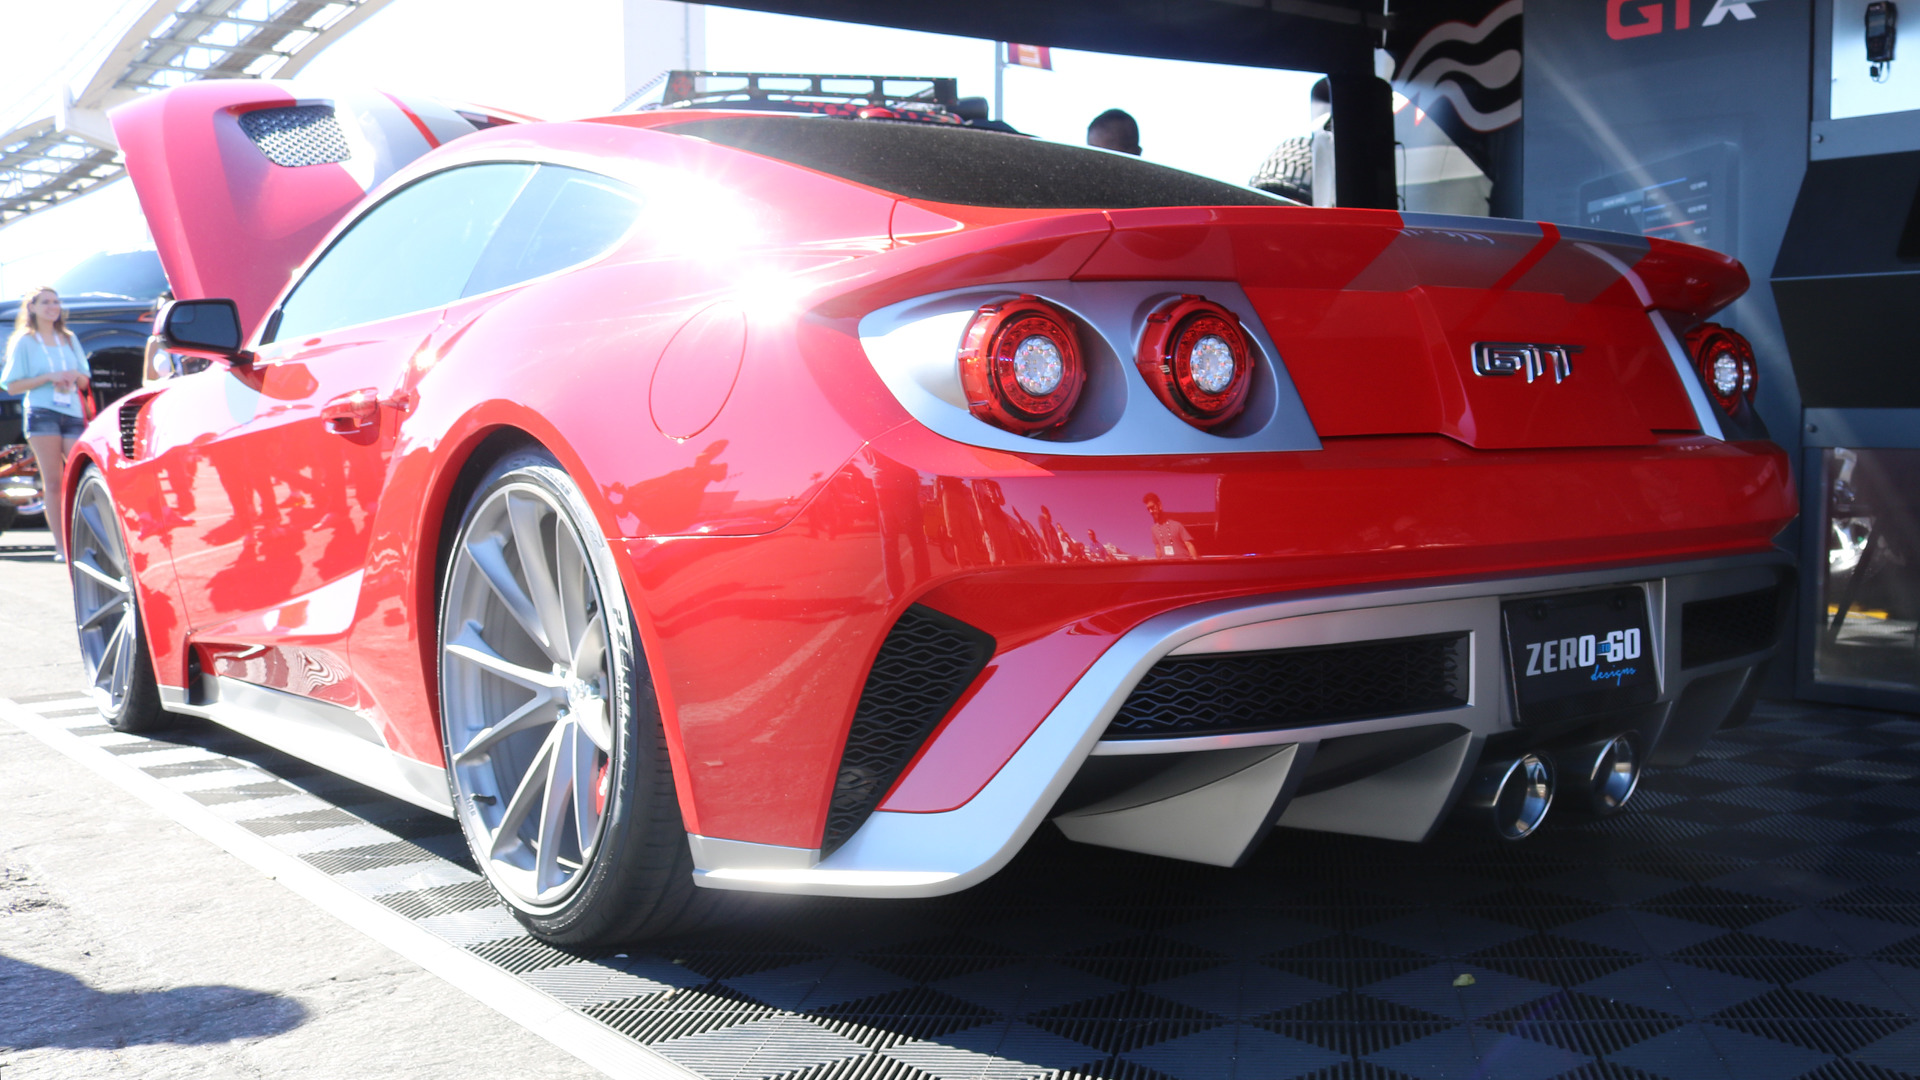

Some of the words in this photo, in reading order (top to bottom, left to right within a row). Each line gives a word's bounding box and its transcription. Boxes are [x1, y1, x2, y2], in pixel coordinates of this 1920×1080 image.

[1470, 341, 1587, 384] GTT
[1526, 634, 1596, 677] ZERO
[1607, 628, 1641, 663] 60
[1591, 664, 1637, 686] designs
